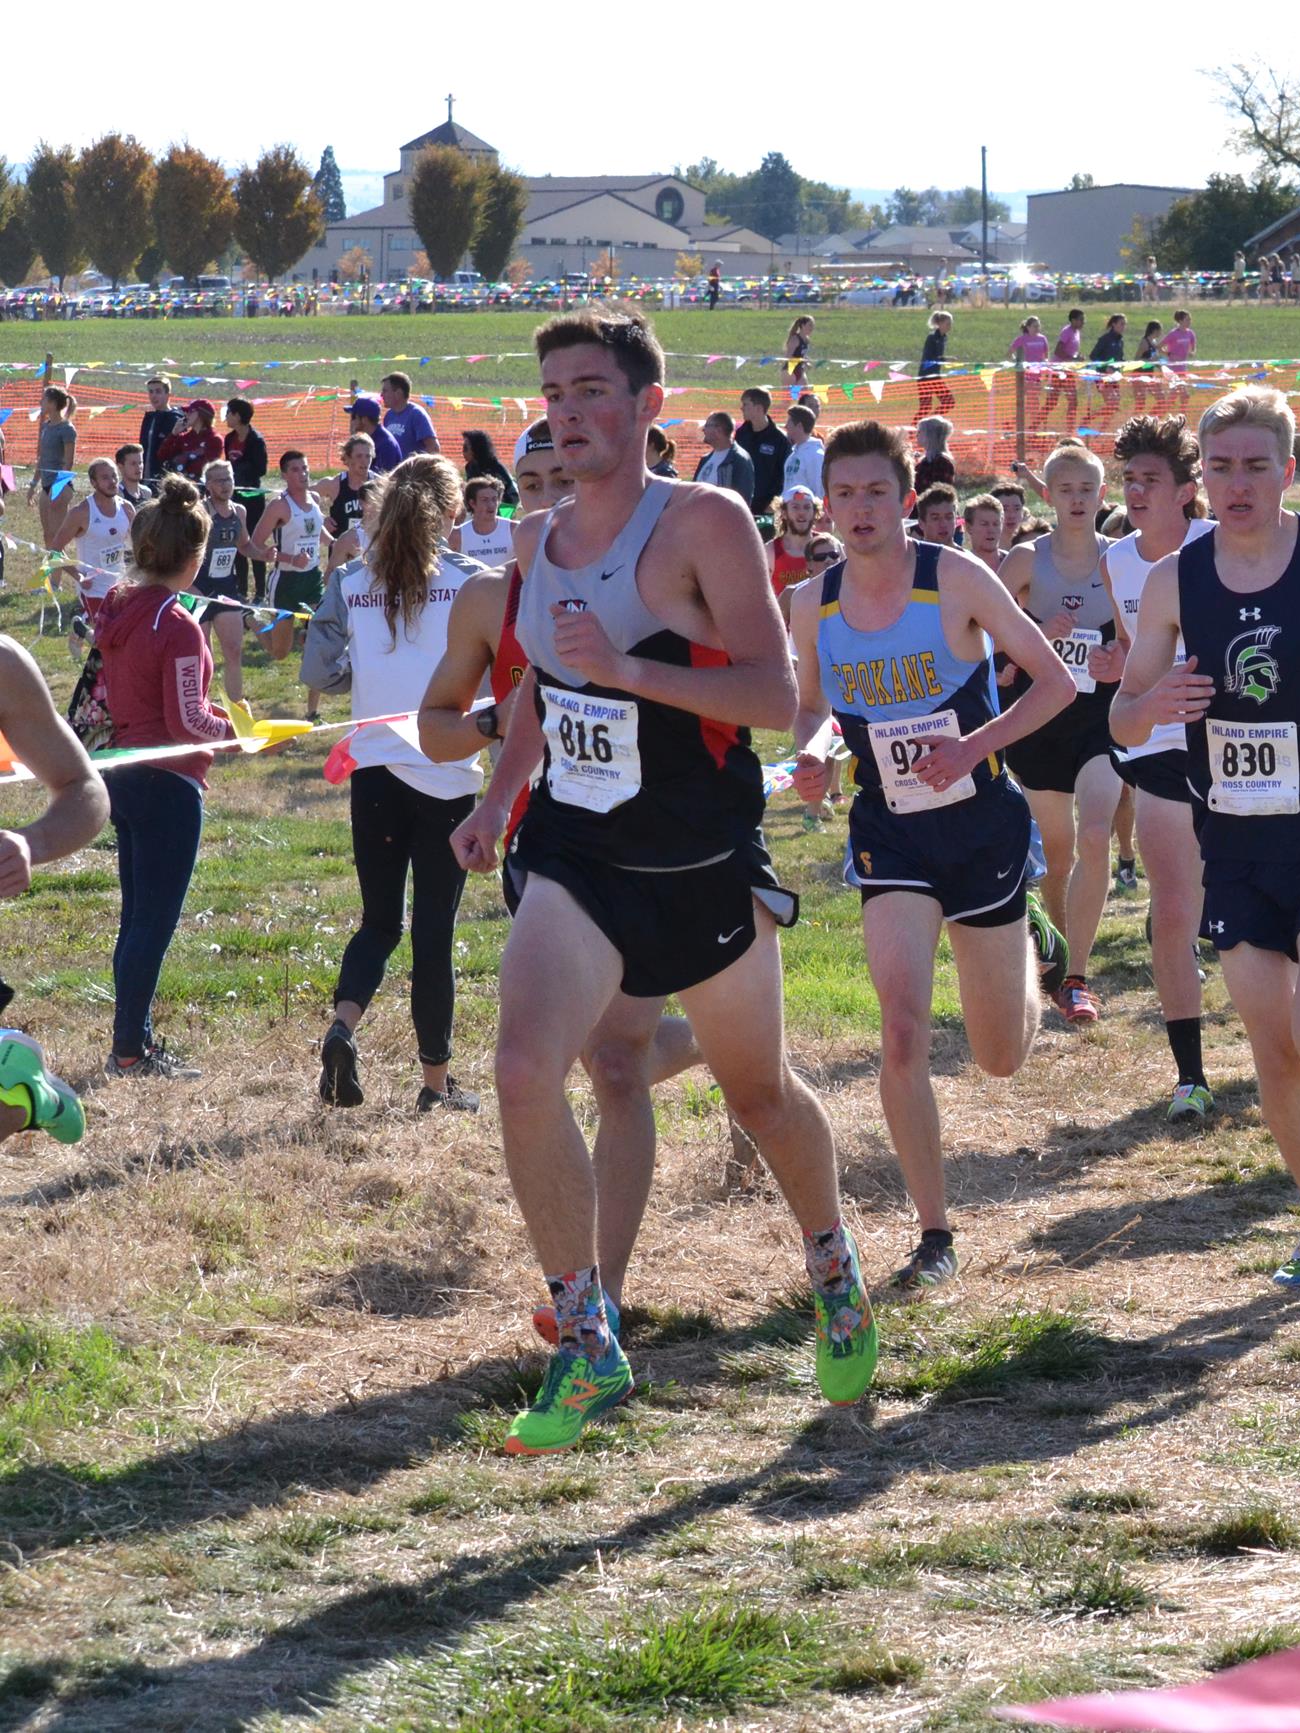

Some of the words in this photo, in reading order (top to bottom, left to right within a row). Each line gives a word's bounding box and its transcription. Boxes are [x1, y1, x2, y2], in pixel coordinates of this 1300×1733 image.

[430, 588, 457, 602] STAT
[1072, 632, 1098, 641] EMPIRE
[182, 663, 198, 697] WSU
[832, 650, 943, 706] SPOKANE
[583, 703, 628, 721] EMPIRE
[874, 725, 909, 739] INLAND
[912, 717, 950, 734] EMPIRE
[1212, 725, 1245, 738] INLAND
[1248, 728, 1289, 739] EMPIRE
[559, 713, 613, 763] 816
[891, 736, 936, 776] 92
[1222, 742, 1276, 778] 830
[581, 765, 621, 780] COUNTRY
[894, 777, 918, 787] CROSS
[1220, 781, 1243, 789] ROSS
[1245, 780, 1282, 789] COUNTRY
